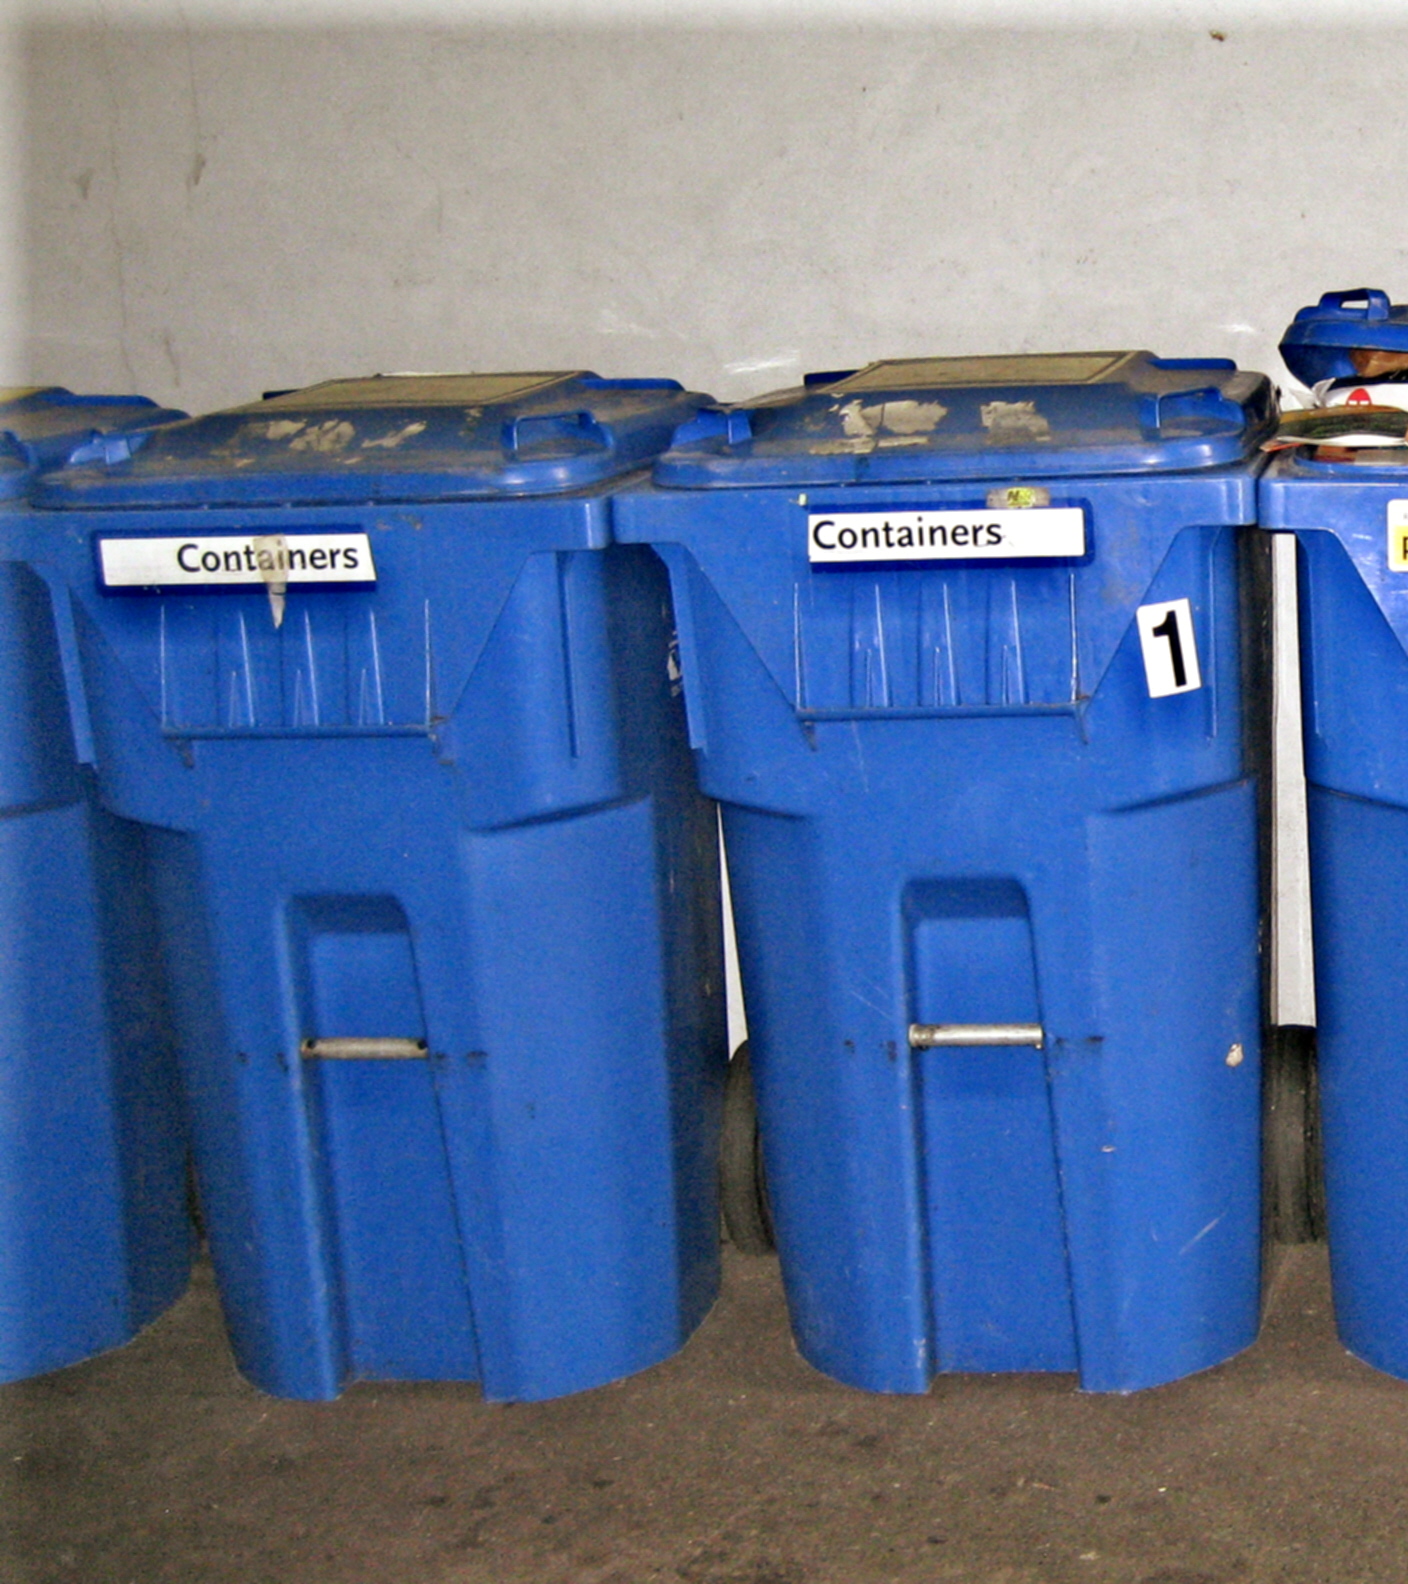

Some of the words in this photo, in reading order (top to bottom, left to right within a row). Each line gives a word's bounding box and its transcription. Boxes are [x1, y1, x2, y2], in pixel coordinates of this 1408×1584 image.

[813, 516, 1002, 549] Containers
[177, 539, 359, 573] Containers
[1152, 610, 1187, 688] 1
